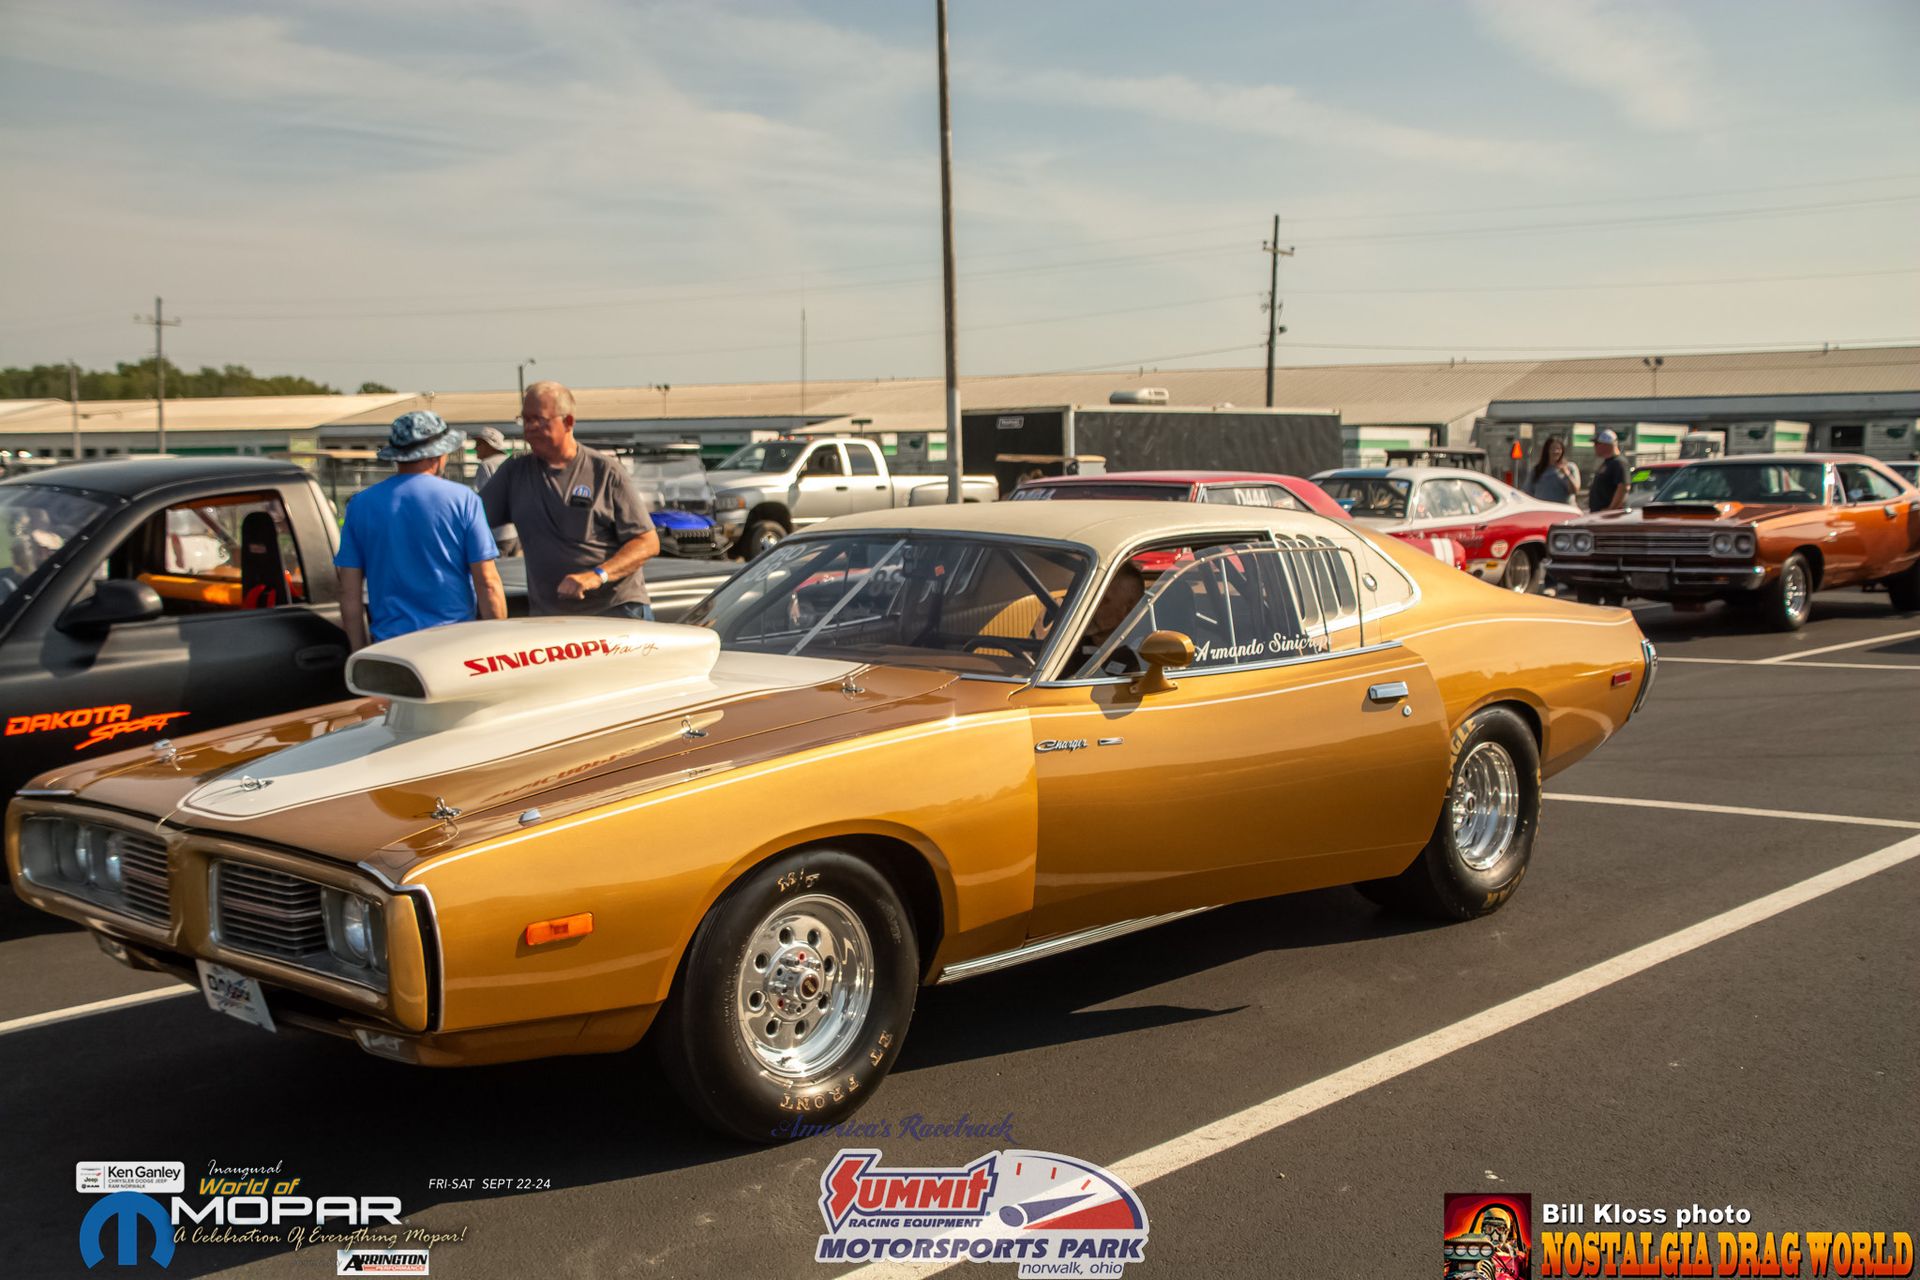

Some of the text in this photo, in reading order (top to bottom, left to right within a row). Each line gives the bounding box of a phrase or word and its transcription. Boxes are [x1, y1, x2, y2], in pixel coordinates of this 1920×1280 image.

[463, 638, 609, 677] SINICROPI
[1195, 632, 1332, 662] Armando Sinicrop
[4, 703, 132, 736] DAKOTA
[1034, 739, 1088, 754] Charger
[780, 1074, 860, 1111] FRONT
